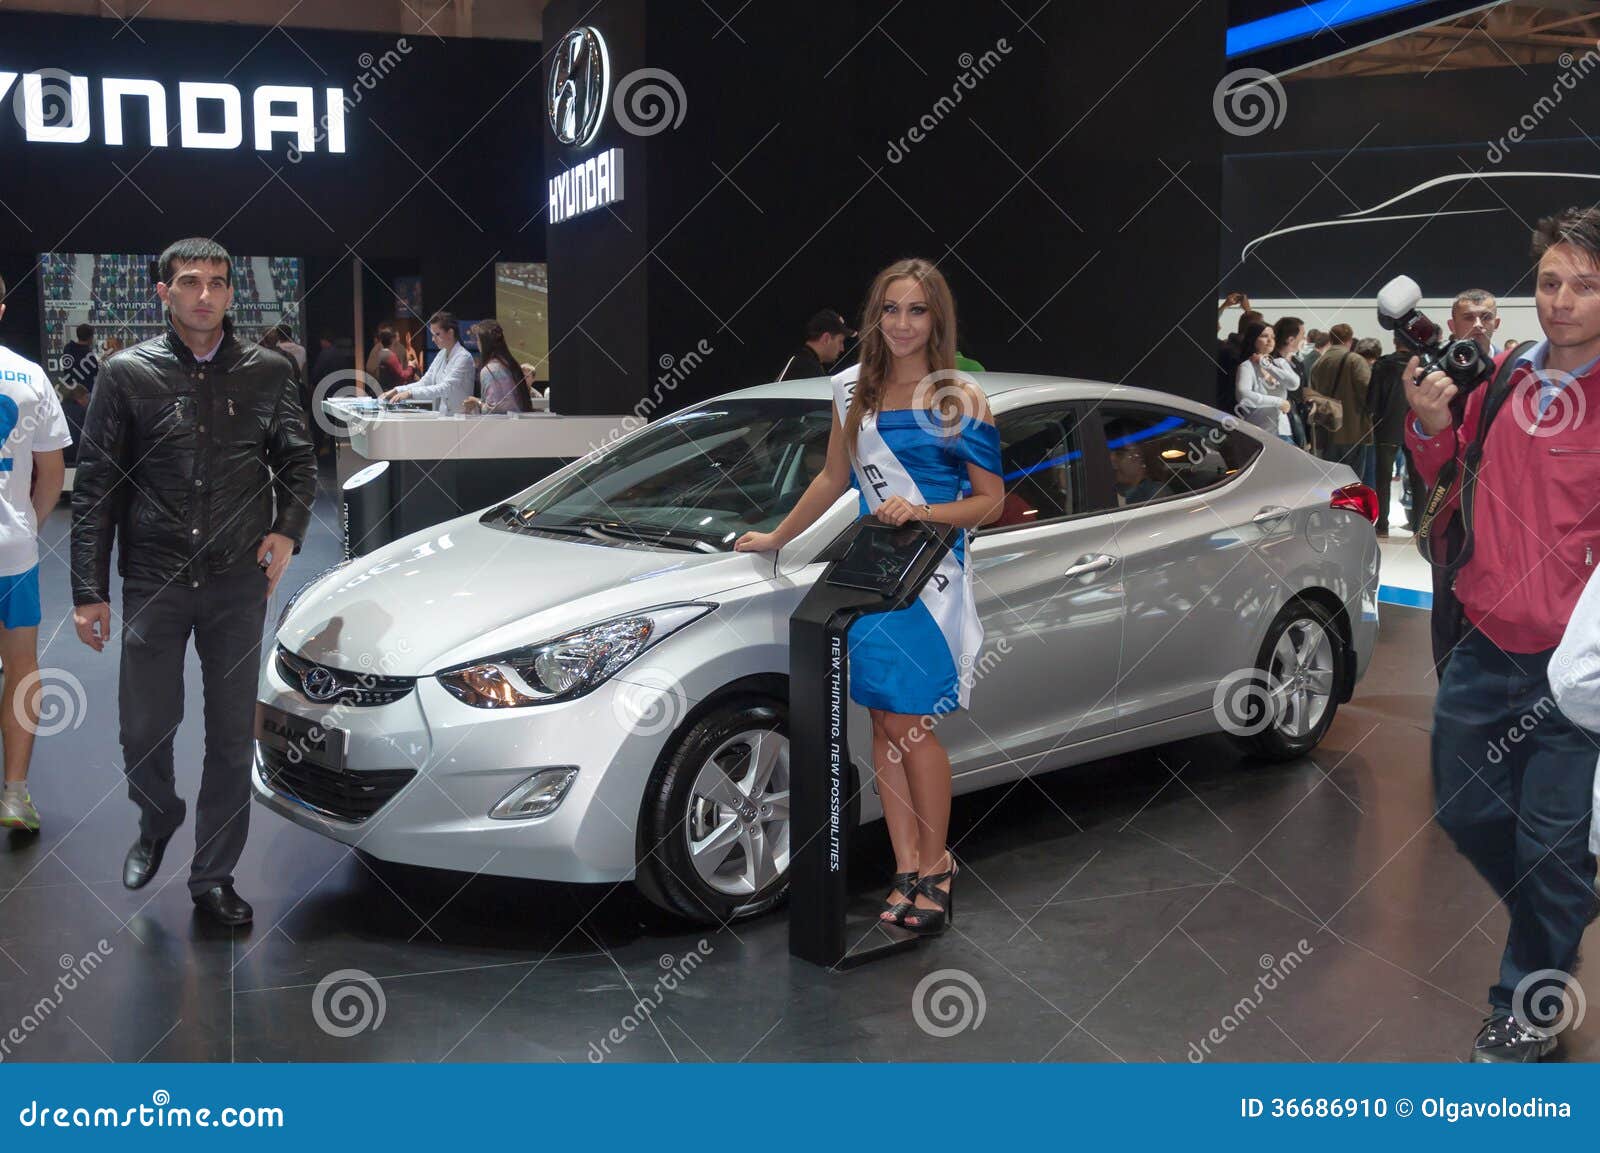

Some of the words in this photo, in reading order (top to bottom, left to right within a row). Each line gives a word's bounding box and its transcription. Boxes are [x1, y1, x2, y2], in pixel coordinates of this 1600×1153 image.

[549, 147, 620, 224] HYUNDAI
[0, 370, 32, 385] DAI
[831, 636, 841, 669] NEW
[831, 671, 841, 740] THINKING.
[830, 743, 840, 777] NEW
[830, 778, 841, 873] POSSIBILITIES.
